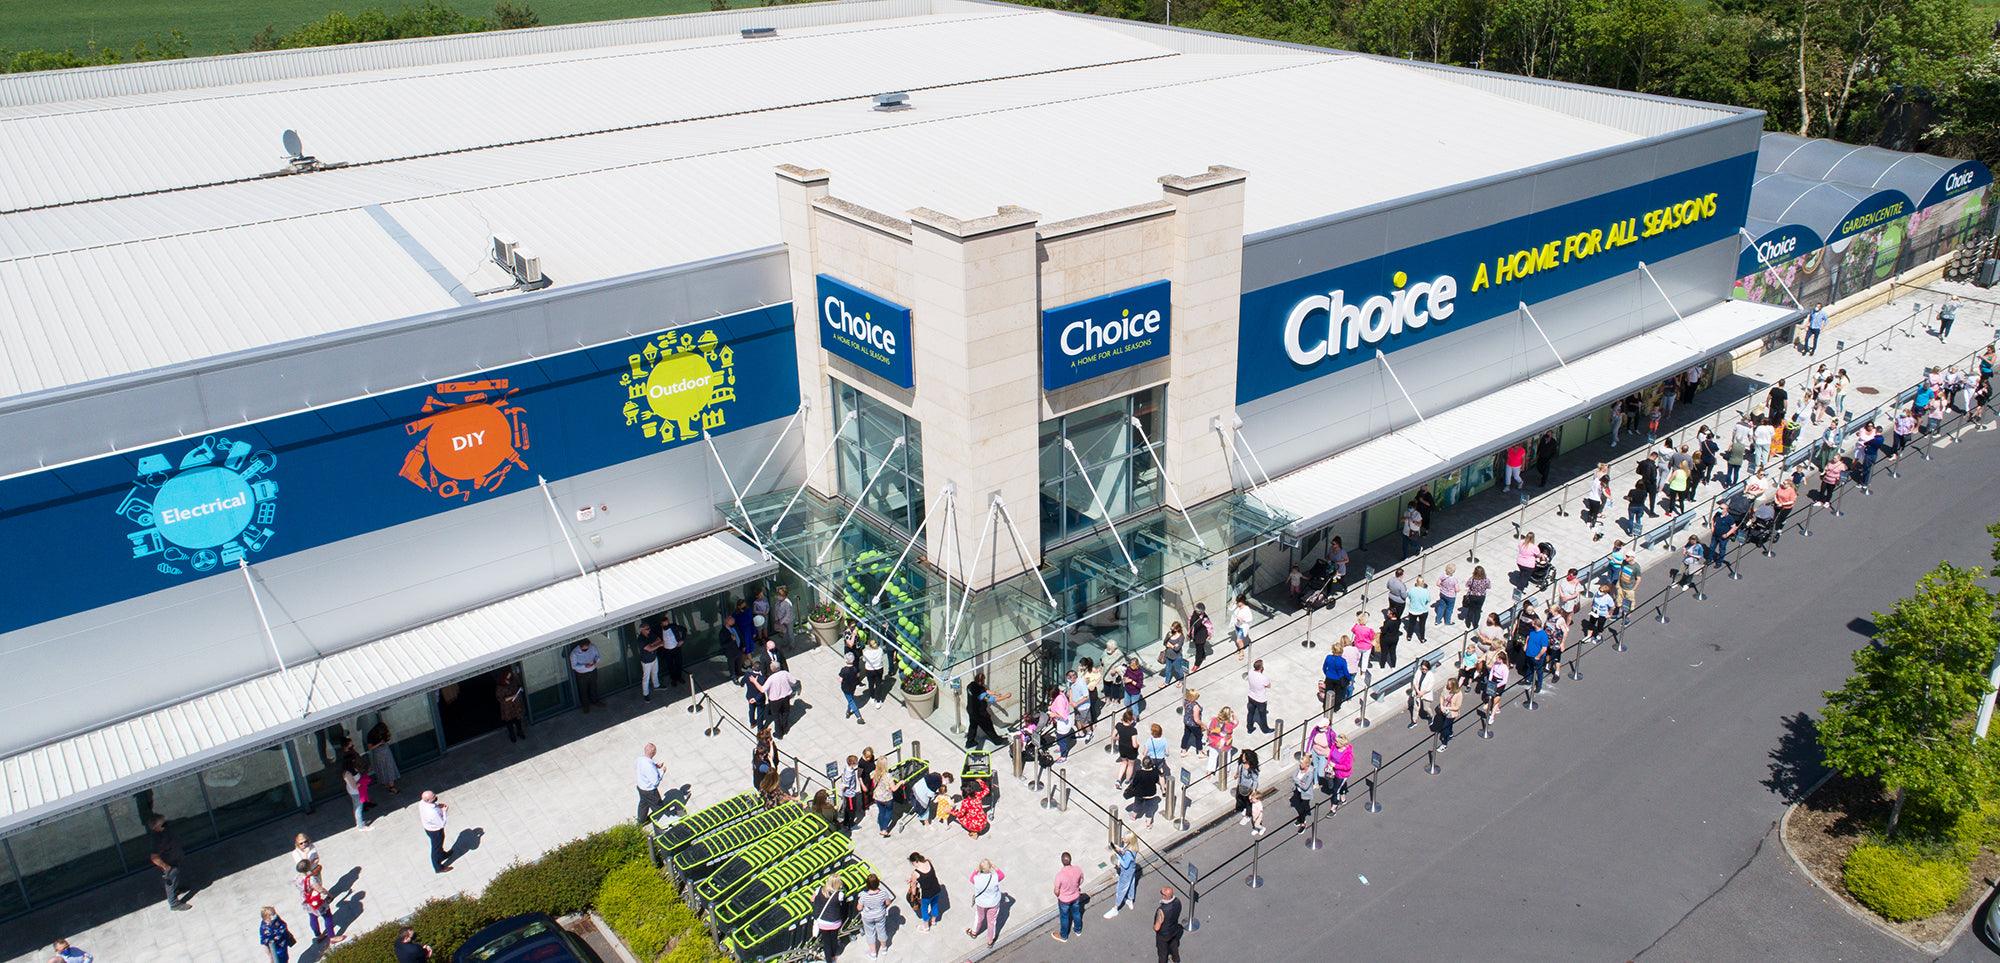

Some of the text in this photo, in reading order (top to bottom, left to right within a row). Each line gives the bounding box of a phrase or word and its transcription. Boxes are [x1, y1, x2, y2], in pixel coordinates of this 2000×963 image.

[1945, 169, 1974, 192] Choice
[1842, 201, 1904, 234] GARDEN CENTRE
[1757, 235, 1796, 264] Choice
[1284, 192, 1718, 366] Choice A HOME FOR ALL SEASONS
[824, 296, 896, 355] Choice
[1060, 308, 1161, 356] Choice
[1077, 354, 1097, 366] HOME
[1098, 350, 1111, 361] FOR
[1112, 347, 1123, 356] ALL
[1124, 338, 1152, 353] SEASONS
[650, 375, 711, 399] Outdoor
[451, 430, 486, 451] DIY
[161, 491, 246, 525] Electrical
